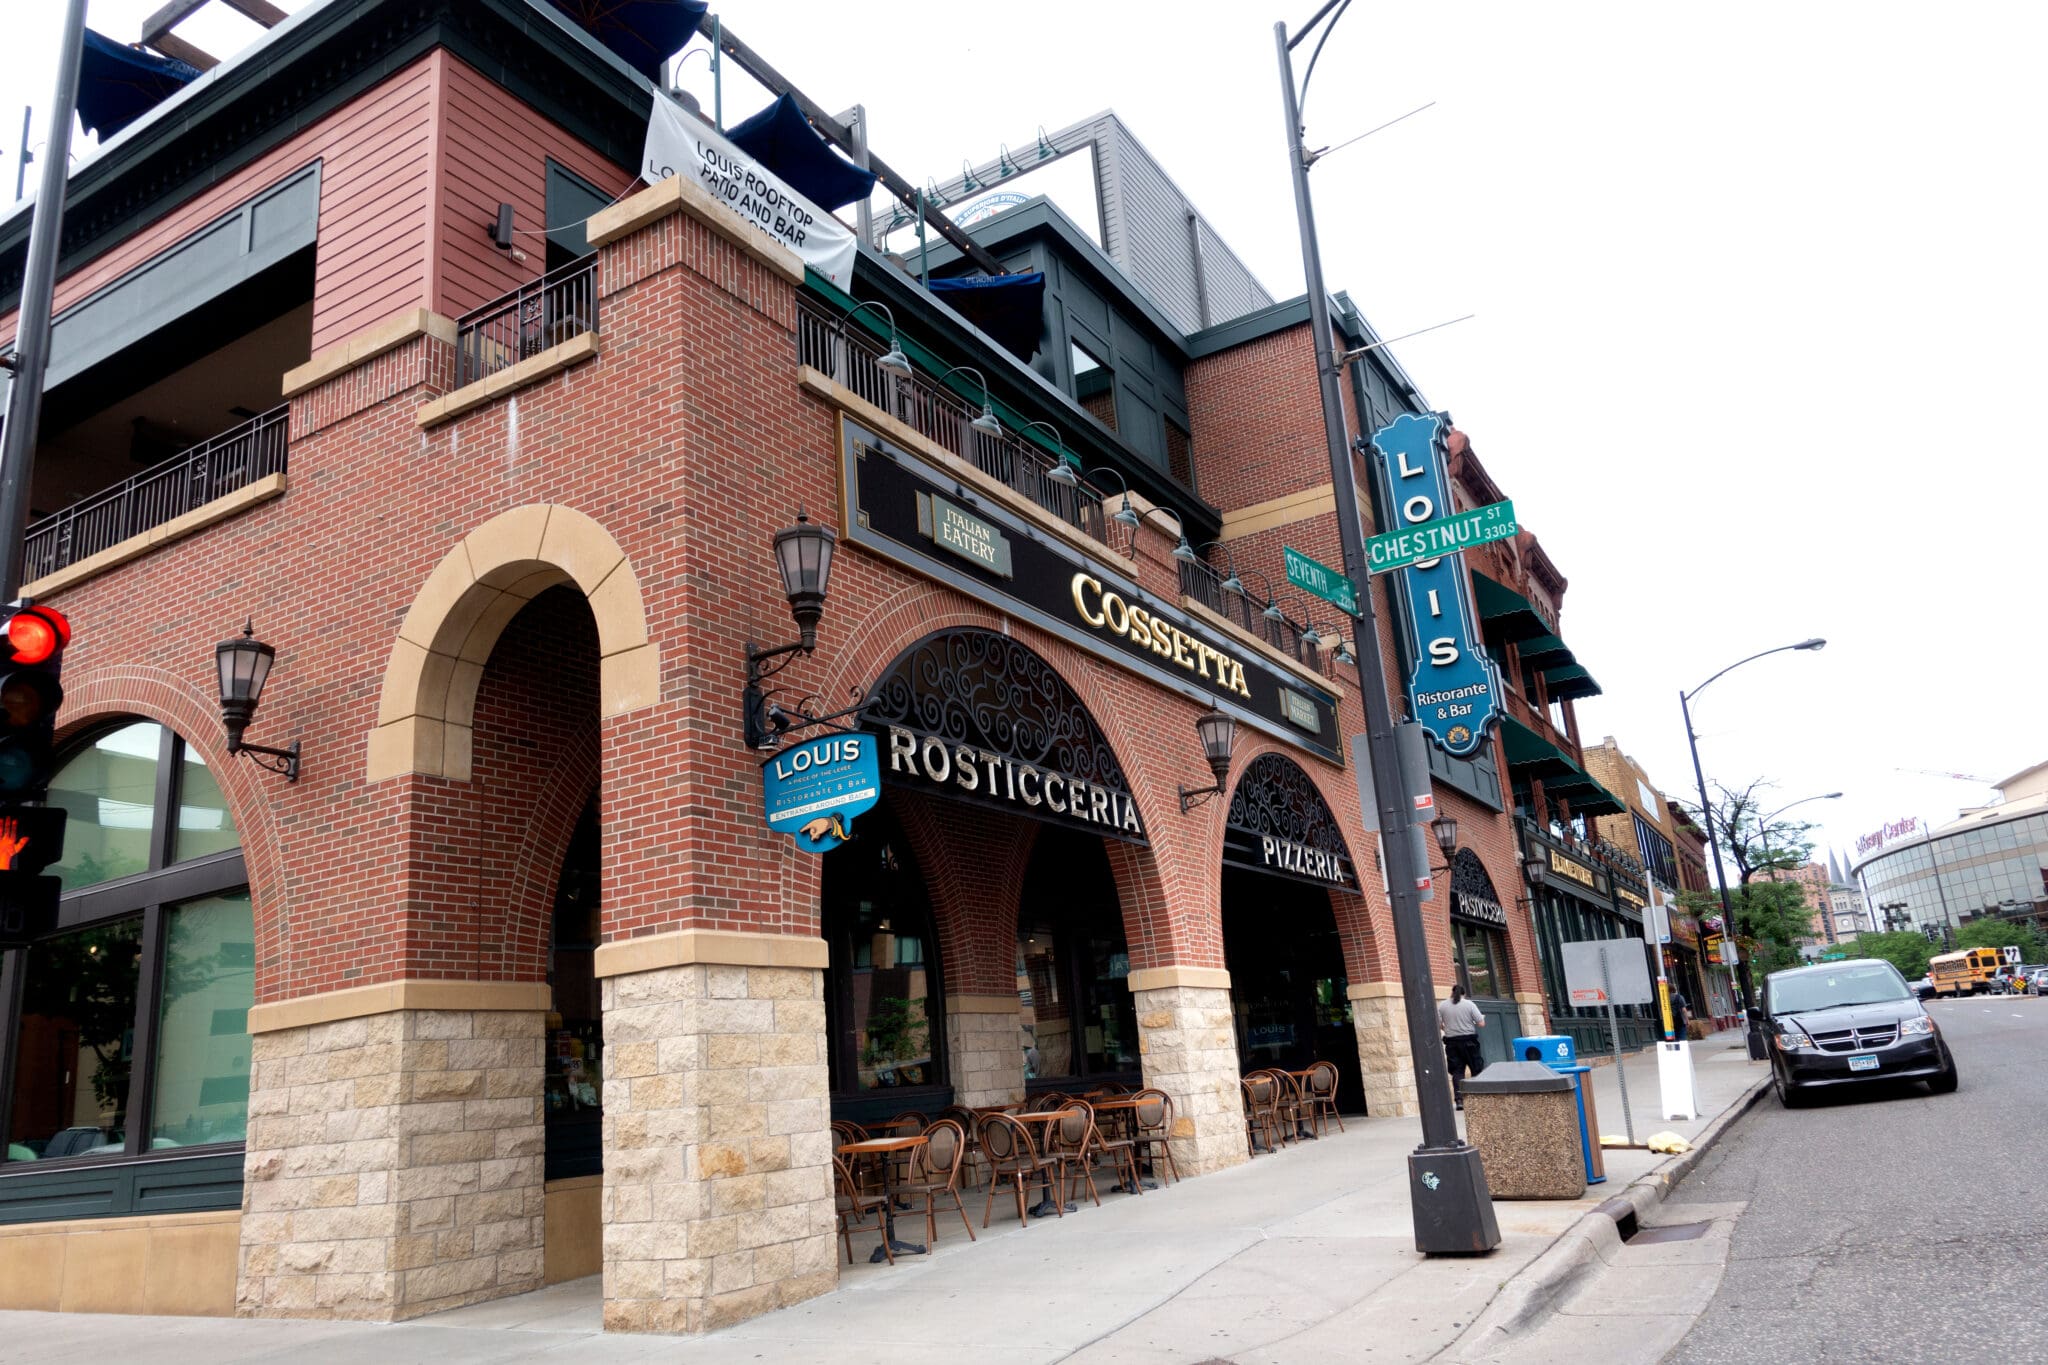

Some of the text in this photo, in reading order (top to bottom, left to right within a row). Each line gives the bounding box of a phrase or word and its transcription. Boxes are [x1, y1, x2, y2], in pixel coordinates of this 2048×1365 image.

[697, 140, 743, 181] LOUIS
[745, 171, 813, 227] ROOFTOP
[700, 163, 739, 201] PATIO
[739, 194, 771, 224] AND
[774, 216, 806, 248] BAR
[943, 521, 995, 563] EATERY
[946, 508, 990, 542] ITALIAN
[1371, 506, 1501, 564] CHESTNUT ST
[1286, 553, 1328, 594] SEVENTH
[1071, 572, 1252, 699] COSSETTA
[1417, 683, 1487, 706] Ristorante
[1437, 704, 1472, 719] & Bar
[775, 740, 860, 780] LOUIS
[888, 725, 1141, 833] ROSTICCERIA
[848, 778, 867, 788] BAR
[775, 791, 869, 820] ENTRANCE AROUND BACK
[1262, 836, 1344, 883] PIZZERIA
[1458, 892, 1506, 925] PASTICCERIA
